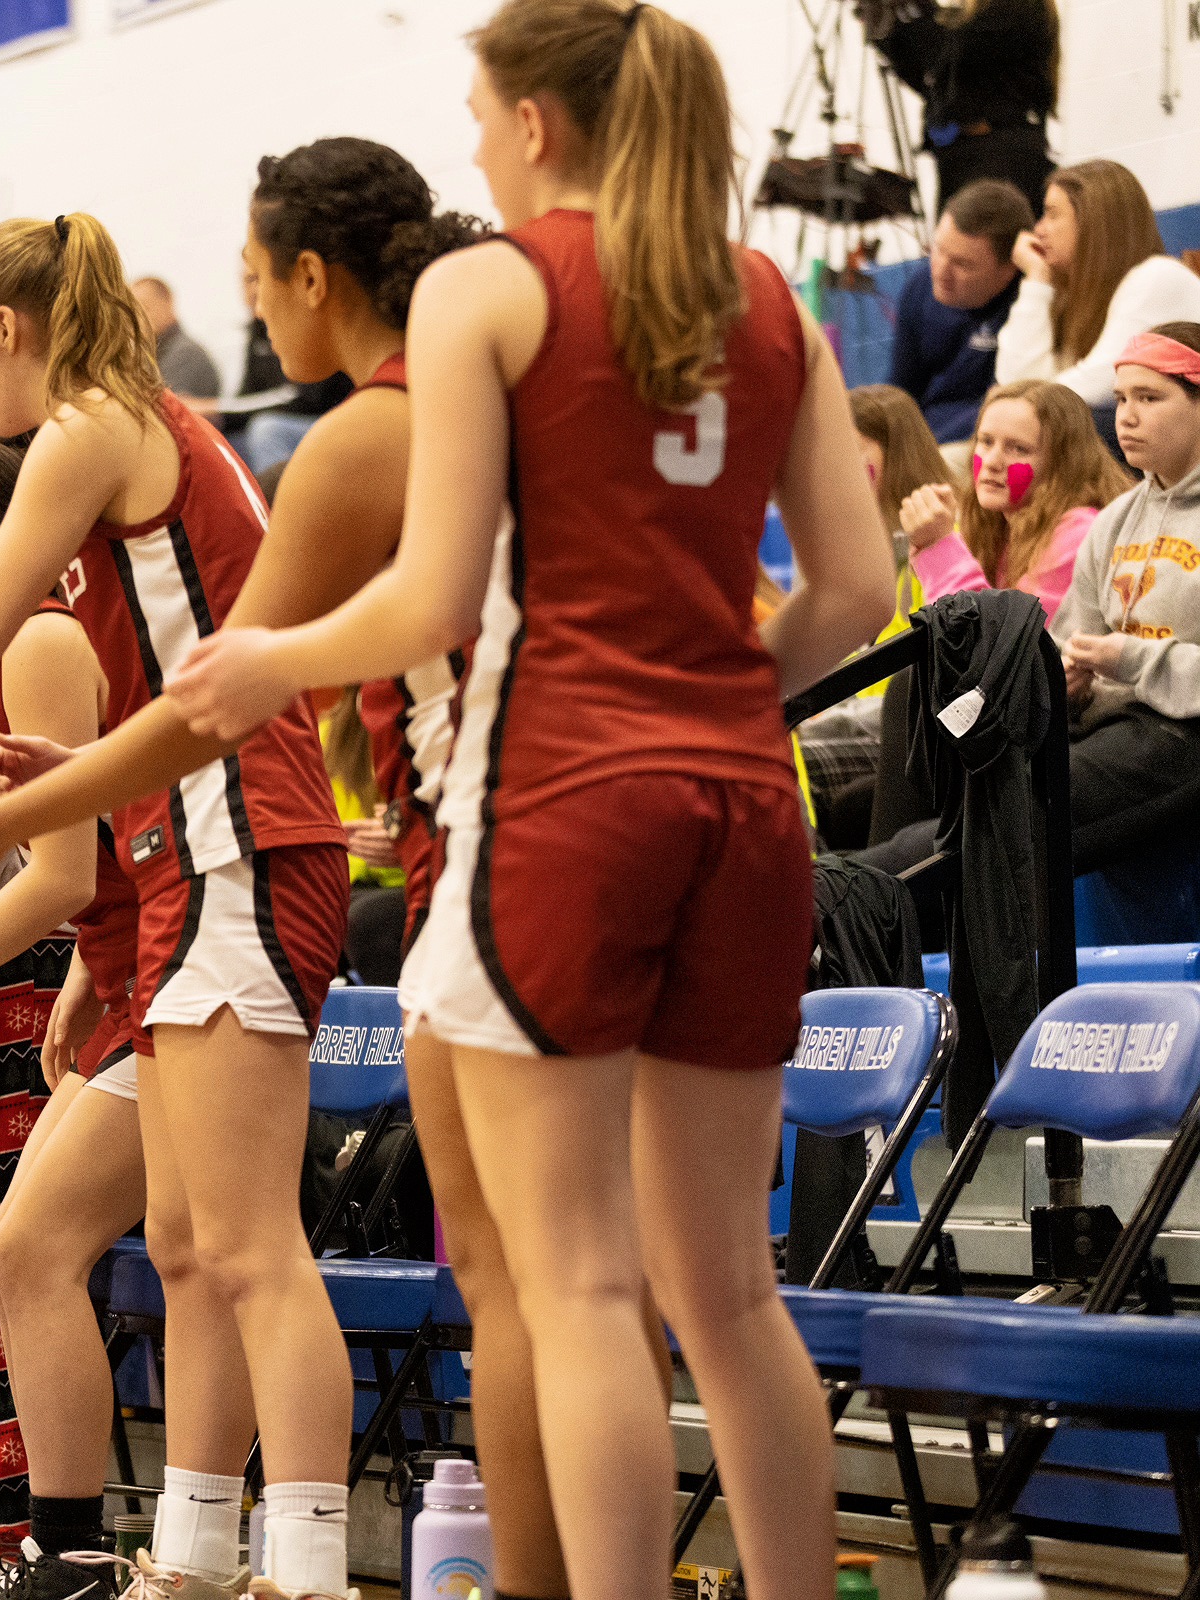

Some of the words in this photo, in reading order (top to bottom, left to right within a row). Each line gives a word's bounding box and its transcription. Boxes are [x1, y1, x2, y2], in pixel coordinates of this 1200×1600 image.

[308, 1024, 367, 1065] RREN
[363, 1026, 405, 1066] HILL
[782, 1025, 858, 1071] ARREN
[848, 1025, 904, 1071] HILLS
[1030, 1021, 1127, 1073] WARREN
[1118, 1021, 1179, 1073] HILLS
